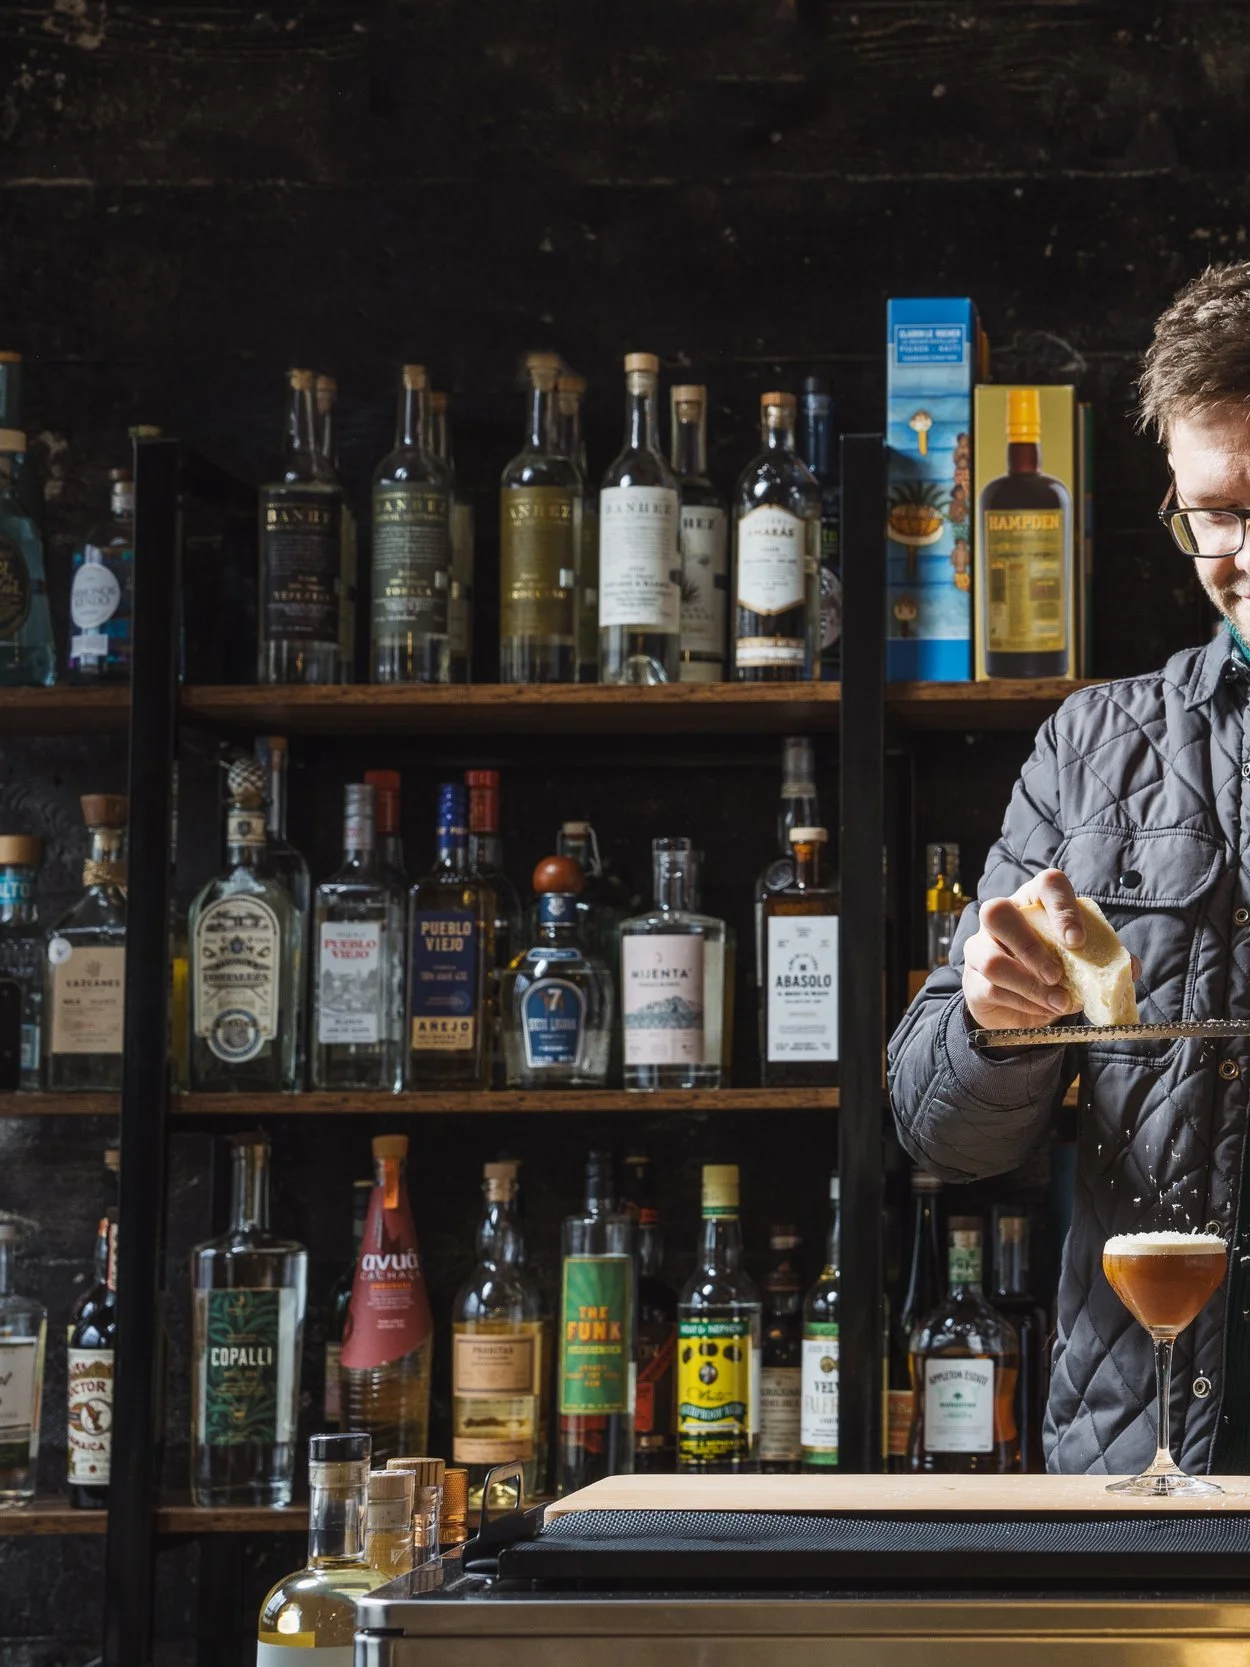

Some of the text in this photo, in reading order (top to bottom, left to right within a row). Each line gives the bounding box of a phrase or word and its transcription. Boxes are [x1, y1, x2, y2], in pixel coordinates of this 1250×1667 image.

[989, 514, 1060, 531] HAMPDEN
[421, 921, 472, 936] PUEBLO
[324, 938, 377, 949] PUEBLO
[426, 937, 464, 952] VIEJO
[775, 974, 832, 989] ABASOLO
[548, 988, 562, 1011] 7
[578, 1306, 609, 1320] THE
[566, 1320, 621, 1342] FUNK
[211, 1346, 272, 1367] COPALLI
[68, 1381, 106, 1396] CTOR
